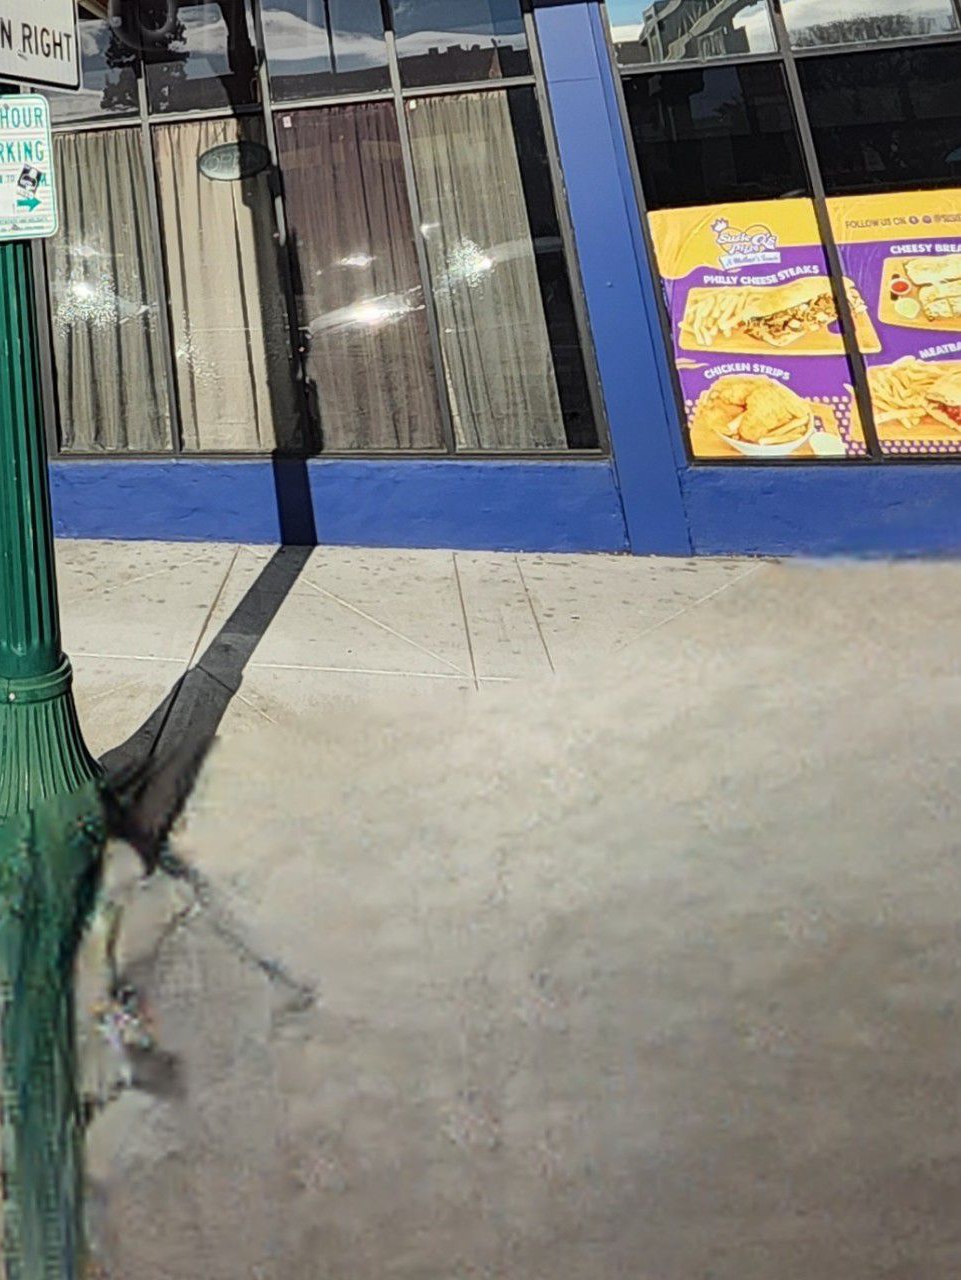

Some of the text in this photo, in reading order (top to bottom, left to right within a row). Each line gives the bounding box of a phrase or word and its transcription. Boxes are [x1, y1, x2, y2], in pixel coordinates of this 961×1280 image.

[21, 23, 72, 62] RIGHT
[0, 107, 44, 129] HOUR
[845, 219, 878, 229] FOLLOW
[890, 244, 933, 254] CHEESY
[703, 265, 820, 285] PHILLY CHEESE STEAKS
[704, 363, 791, 380] CHICKEN STRIPS
